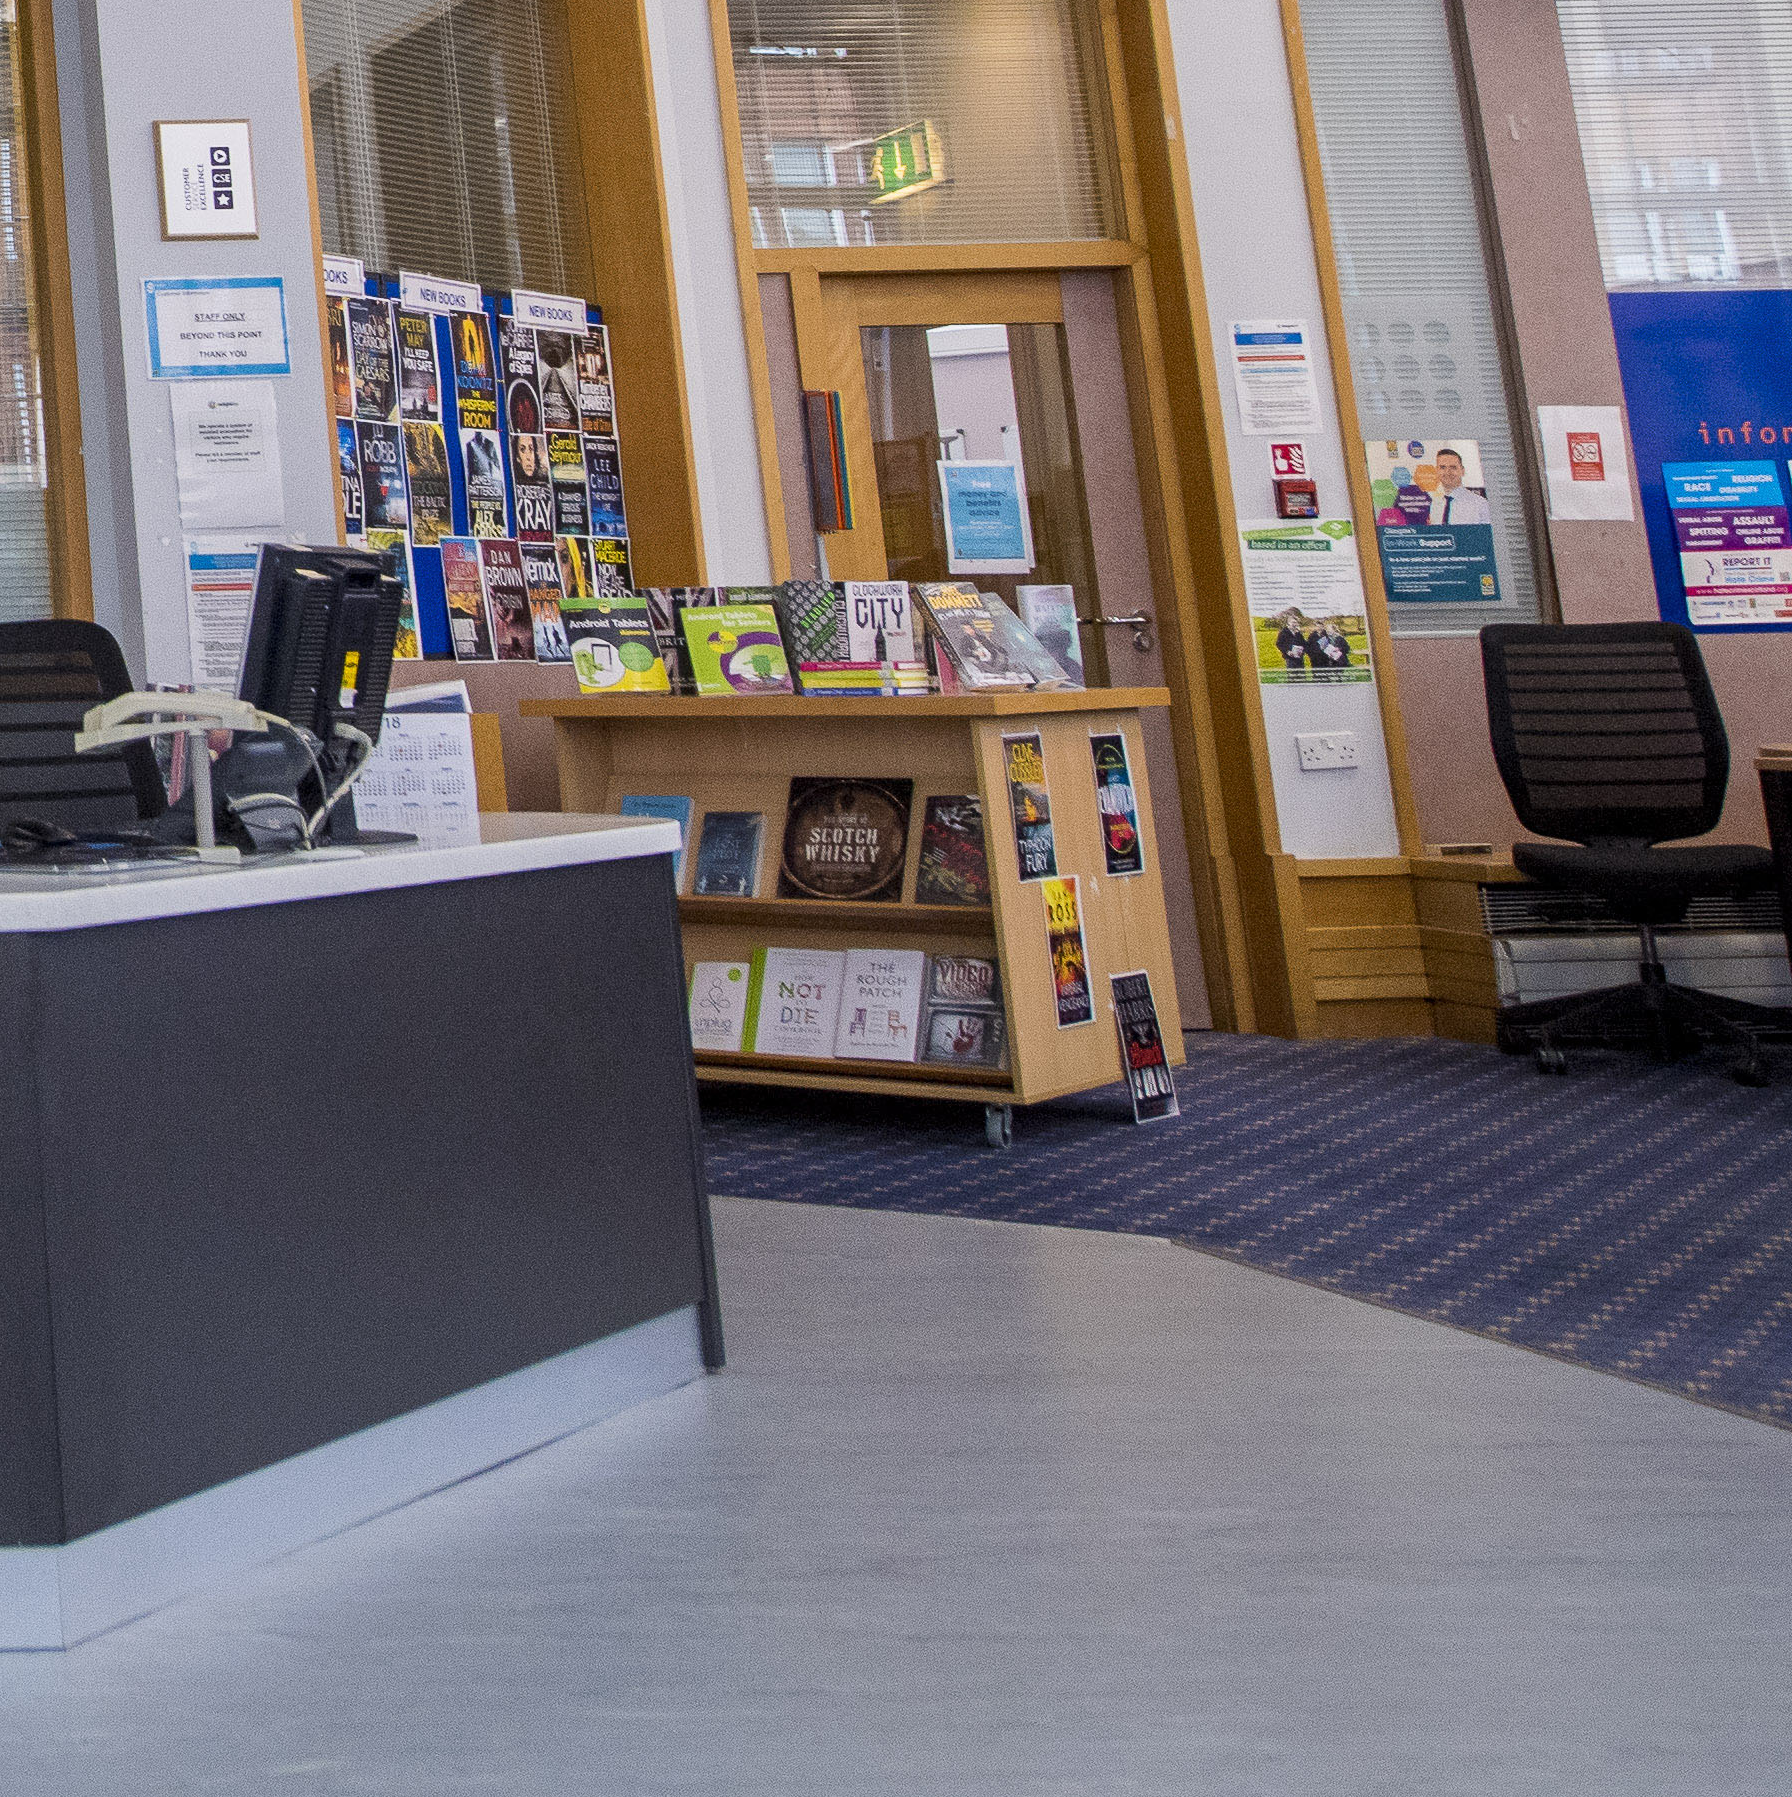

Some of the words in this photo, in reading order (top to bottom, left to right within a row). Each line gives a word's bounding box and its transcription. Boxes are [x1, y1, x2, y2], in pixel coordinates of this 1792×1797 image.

[420, 287, 436, 302] NEW
[439, 292, 466, 308] BOOKS
[194, 312, 219, 321] STAFF
[222, 312, 245, 321] ONLY
[529, 305, 546, 318] NEW
[548, 308, 573, 322] BOOKS
[399, 317, 427, 333] PETER
[180, 331, 214, 340] BEYOND
[216, 331, 235, 339] THIS
[237, 330, 262, 339] POINT
[407, 333, 423, 347] MAY
[199, 350, 227, 358] THANK
[230, 350, 247, 358] YOU
[464, 412, 491, 428] ROOM
[364, 439, 397, 464] ROBB
[594, 458, 611, 473] LEE
[590, 473, 619, 490] CHILD
[1732, 474, 1773, 483] RELIGION
[1683, 482, 1712, 492] RACE
[517, 499, 552, 530] KRAY
[1732, 515, 1775, 526] ASSAULT
[1688, 527, 1729, 537] SPITTING
[1419, 538, 1453, 548] Support
[490, 550, 512, 565] DAN
[1721, 557, 1761, 566] REPORT
[1763, 556, 1772, 565] IT
[486, 567, 524, 588] BROWN
[852, 583, 903, 597] CLOCKWORK
[854, 598, 903, 629] CITY
[569, 618, 610, 629] Android
[612, 618, 650, 629] Tablets
[809, 827, 879, 845] SCOTCH
[804, 844, 881, 863] WHISKY
[1025, 852, 1049, 873] FURY
[870, 962, 897, 974] THE
[856, 974, 907, 987] ROUGH
[778, 982, 826, 1001] NOT
[858, 986, 903, 999] PATCH
[780, 1006, 820, 1025] DIE
